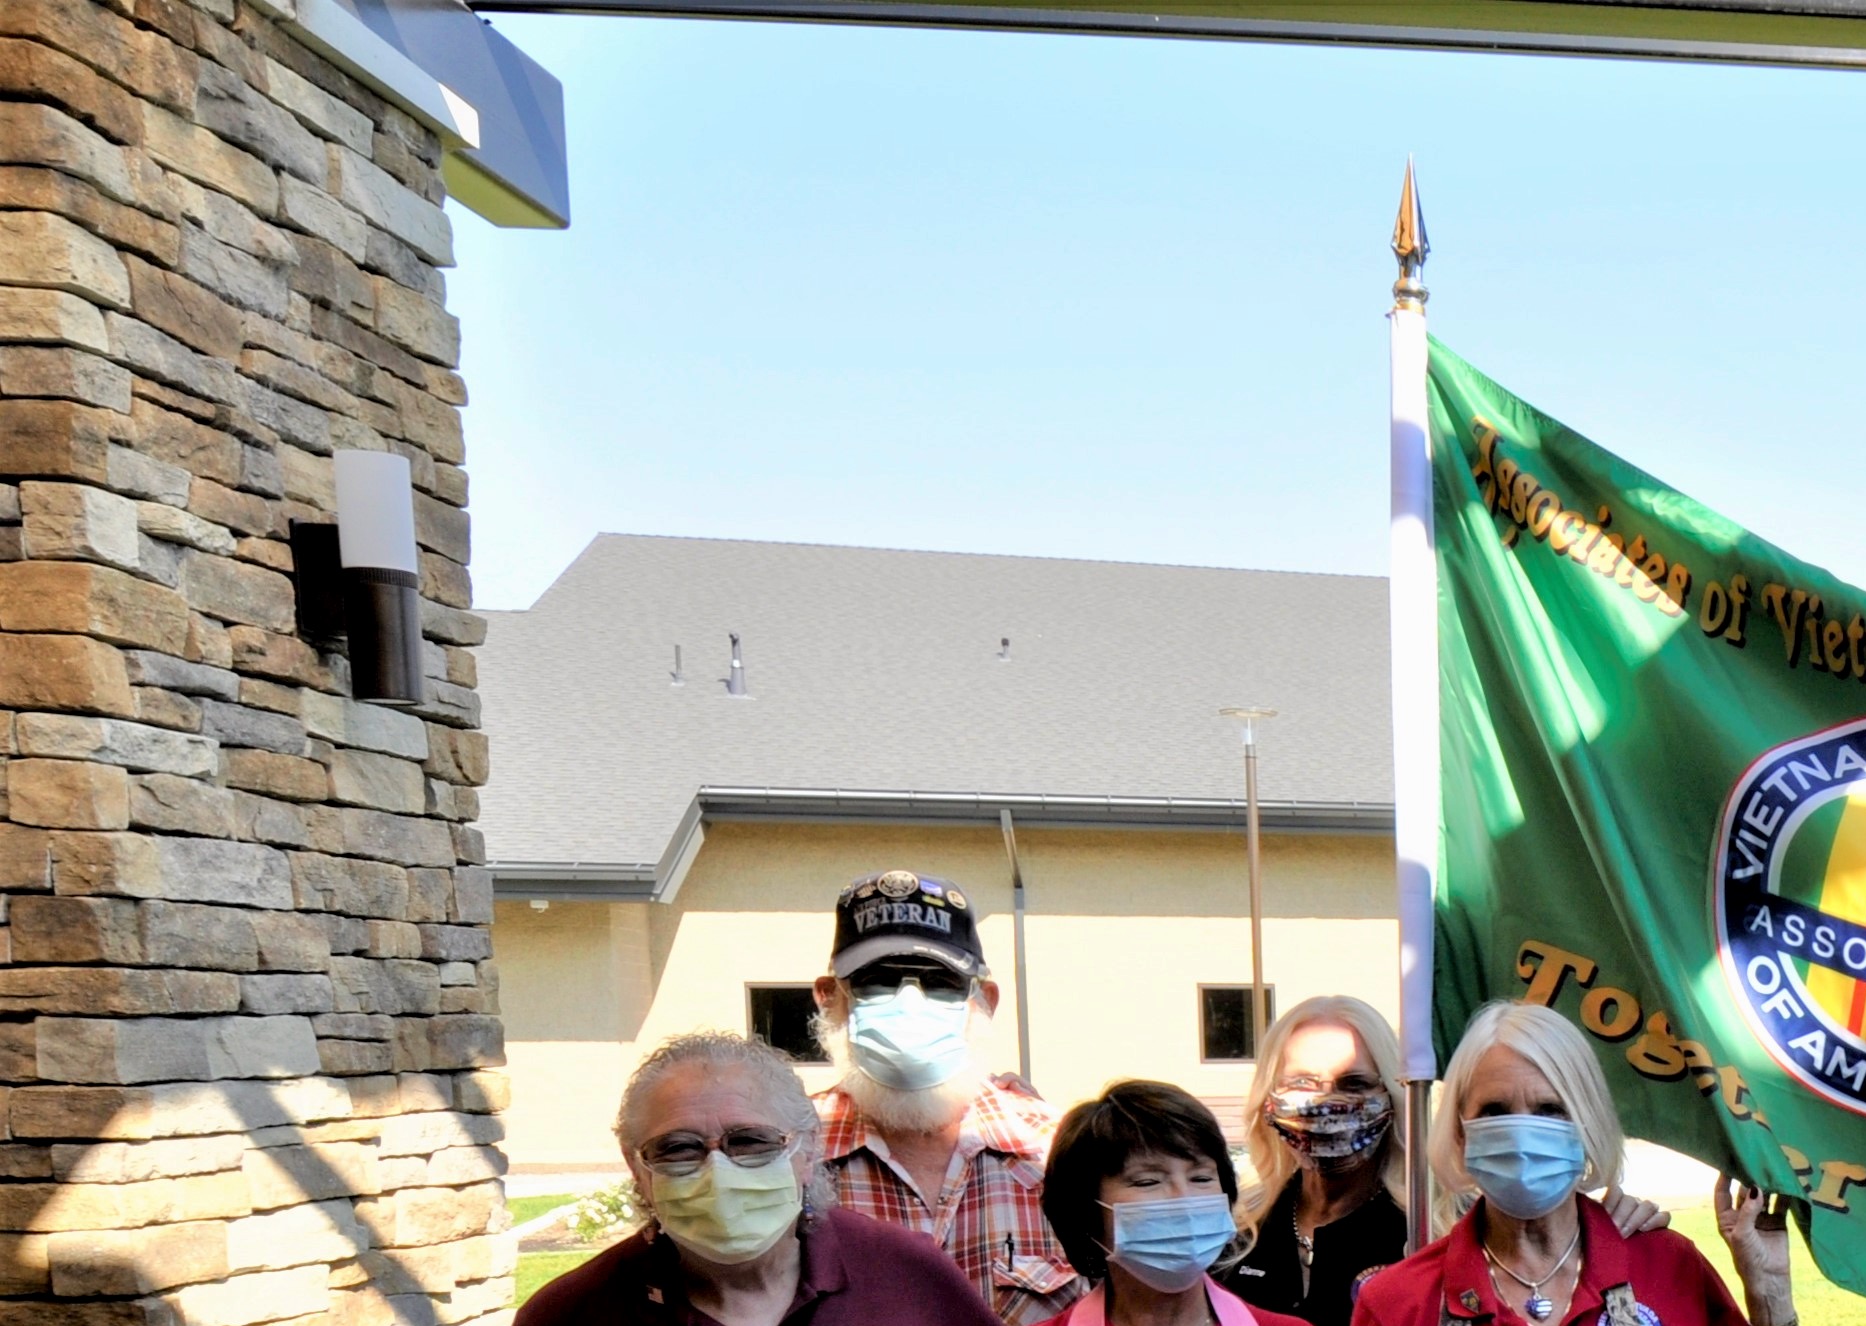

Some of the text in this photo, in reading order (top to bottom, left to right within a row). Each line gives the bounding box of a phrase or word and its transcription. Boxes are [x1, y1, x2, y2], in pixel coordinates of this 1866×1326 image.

[1472, 414, 1691, 618] Associates
[1699, 574, 1750, 649] of
[853, 902, 952, 934] VETERAN
[1746, 955, 1805, 1021] OF
